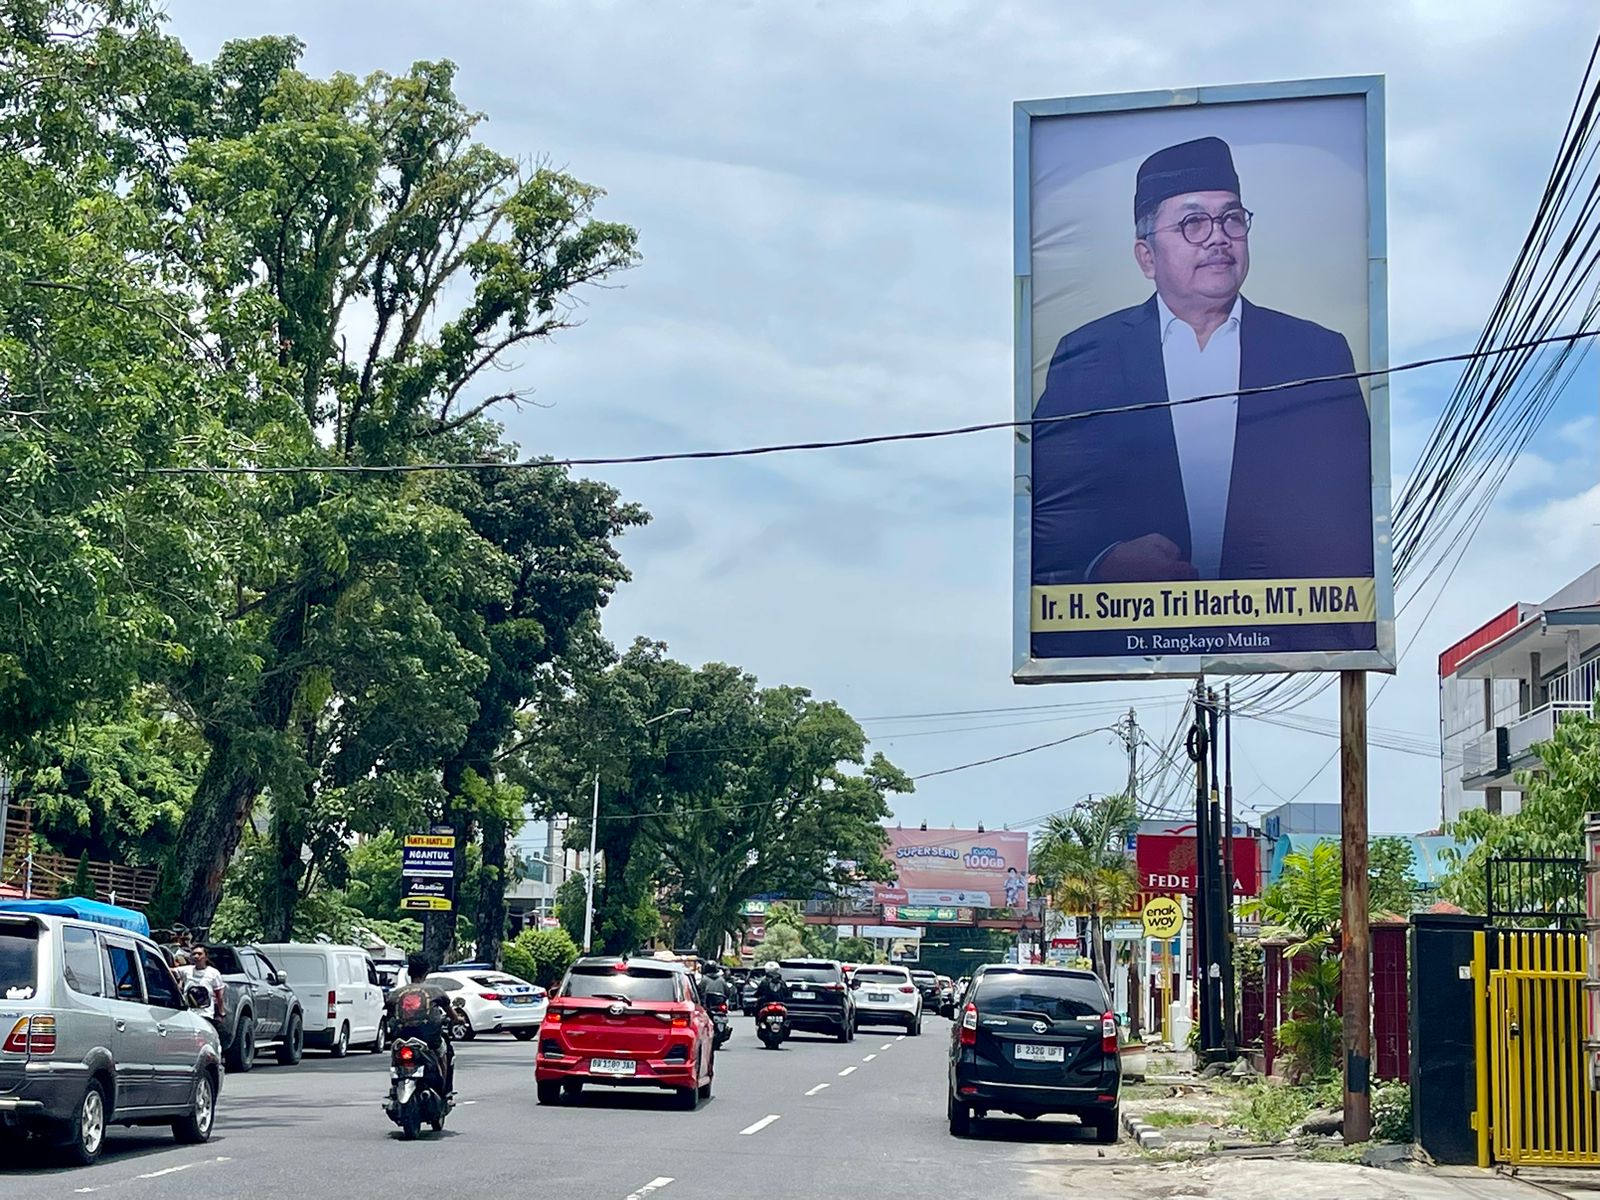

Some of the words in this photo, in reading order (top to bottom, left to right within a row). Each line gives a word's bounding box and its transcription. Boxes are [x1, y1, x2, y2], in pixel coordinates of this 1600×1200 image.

[1041, 594, 1063, 620] Ir.
[1069, 593, 1090, 619] H.
[1096, 592, 1154, 621] Surya
[1160, 590, 1188, 617] Tri
[1195, 588, 1259, 618] Harto,
[1265, 587, 1303, 616] MT,
[1309, 585, 1359, 614] MBA
[1127, 635, 1148, 650] Dt.
[1152, 633, 1224, 652] Rangkayo
[1227, 633, 1270, 648] Mulia
[963, 856, 1005, 868] 100GB
[1146, 905, 1176, 917] enak
[1016, 1045, 1022, 1054] B
